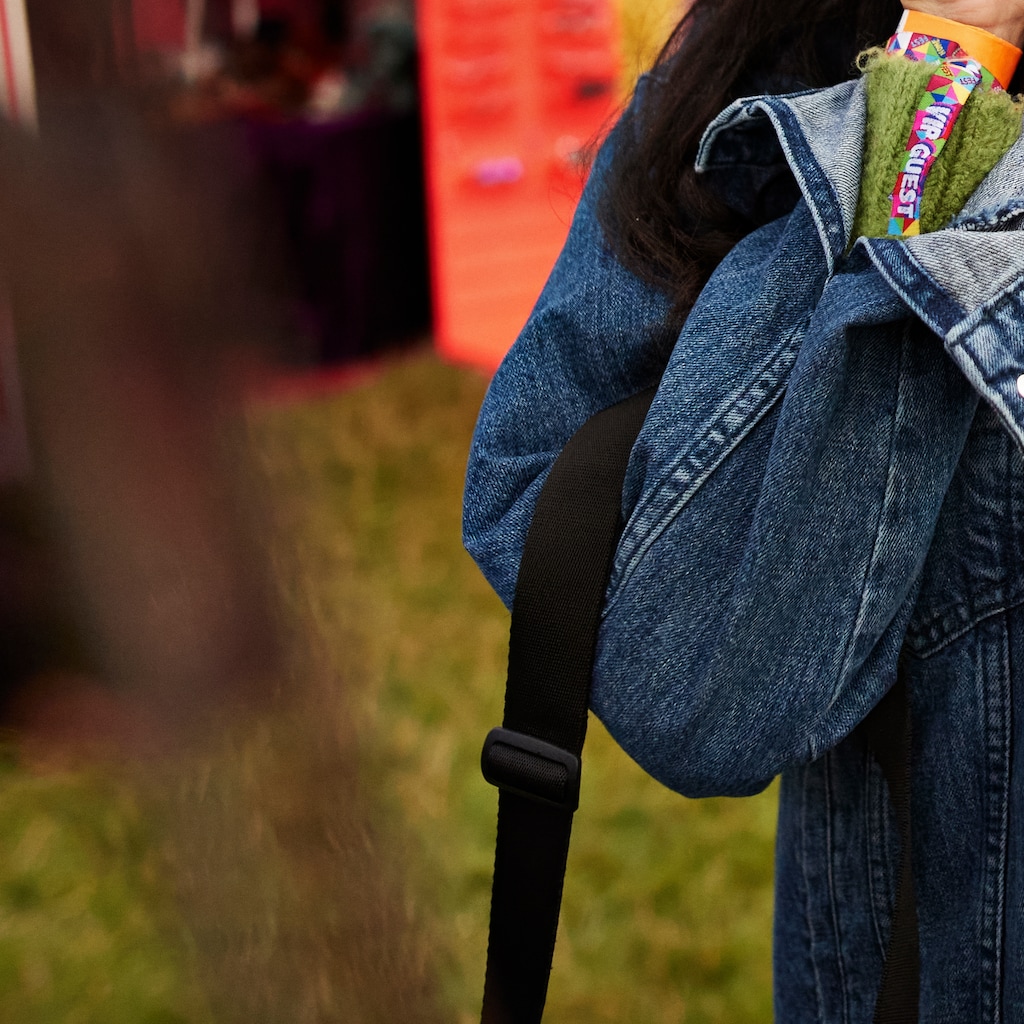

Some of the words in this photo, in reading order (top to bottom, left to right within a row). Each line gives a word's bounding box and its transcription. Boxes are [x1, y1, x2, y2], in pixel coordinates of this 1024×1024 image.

[960, 76, 977, 85] FEST
[920, 105, 951, 140] VIP
[897, 143, 931, 219] GUEST
